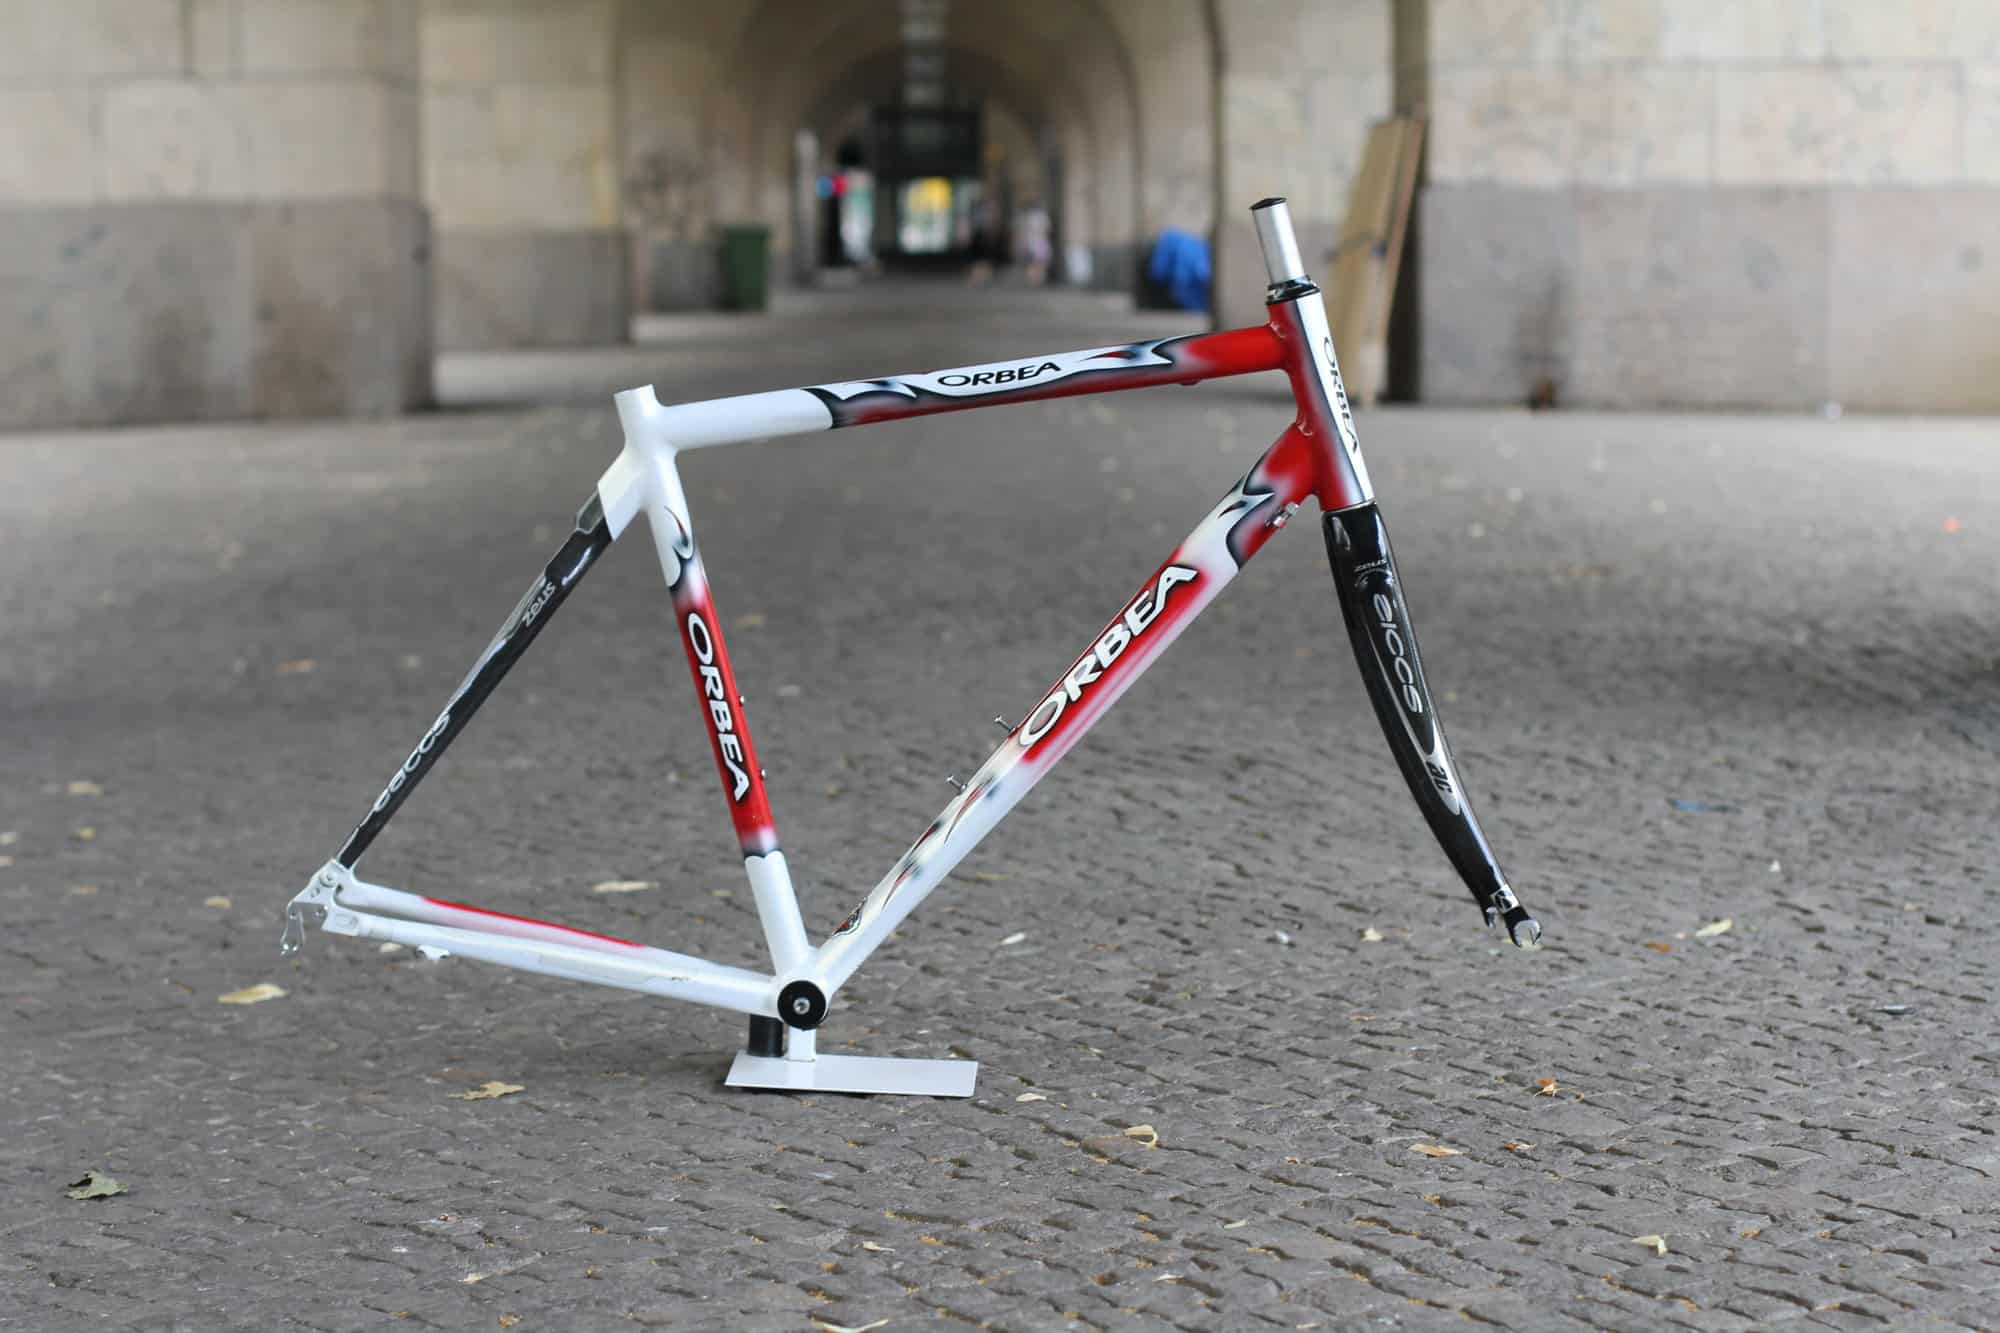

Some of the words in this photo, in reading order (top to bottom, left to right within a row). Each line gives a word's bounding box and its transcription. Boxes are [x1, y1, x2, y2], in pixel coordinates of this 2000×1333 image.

[937, 362, 1061, 386] ORBEA
[688, 612, 750, 801] ORBEA
[1019, 565, 1198, 746] ORBEA
